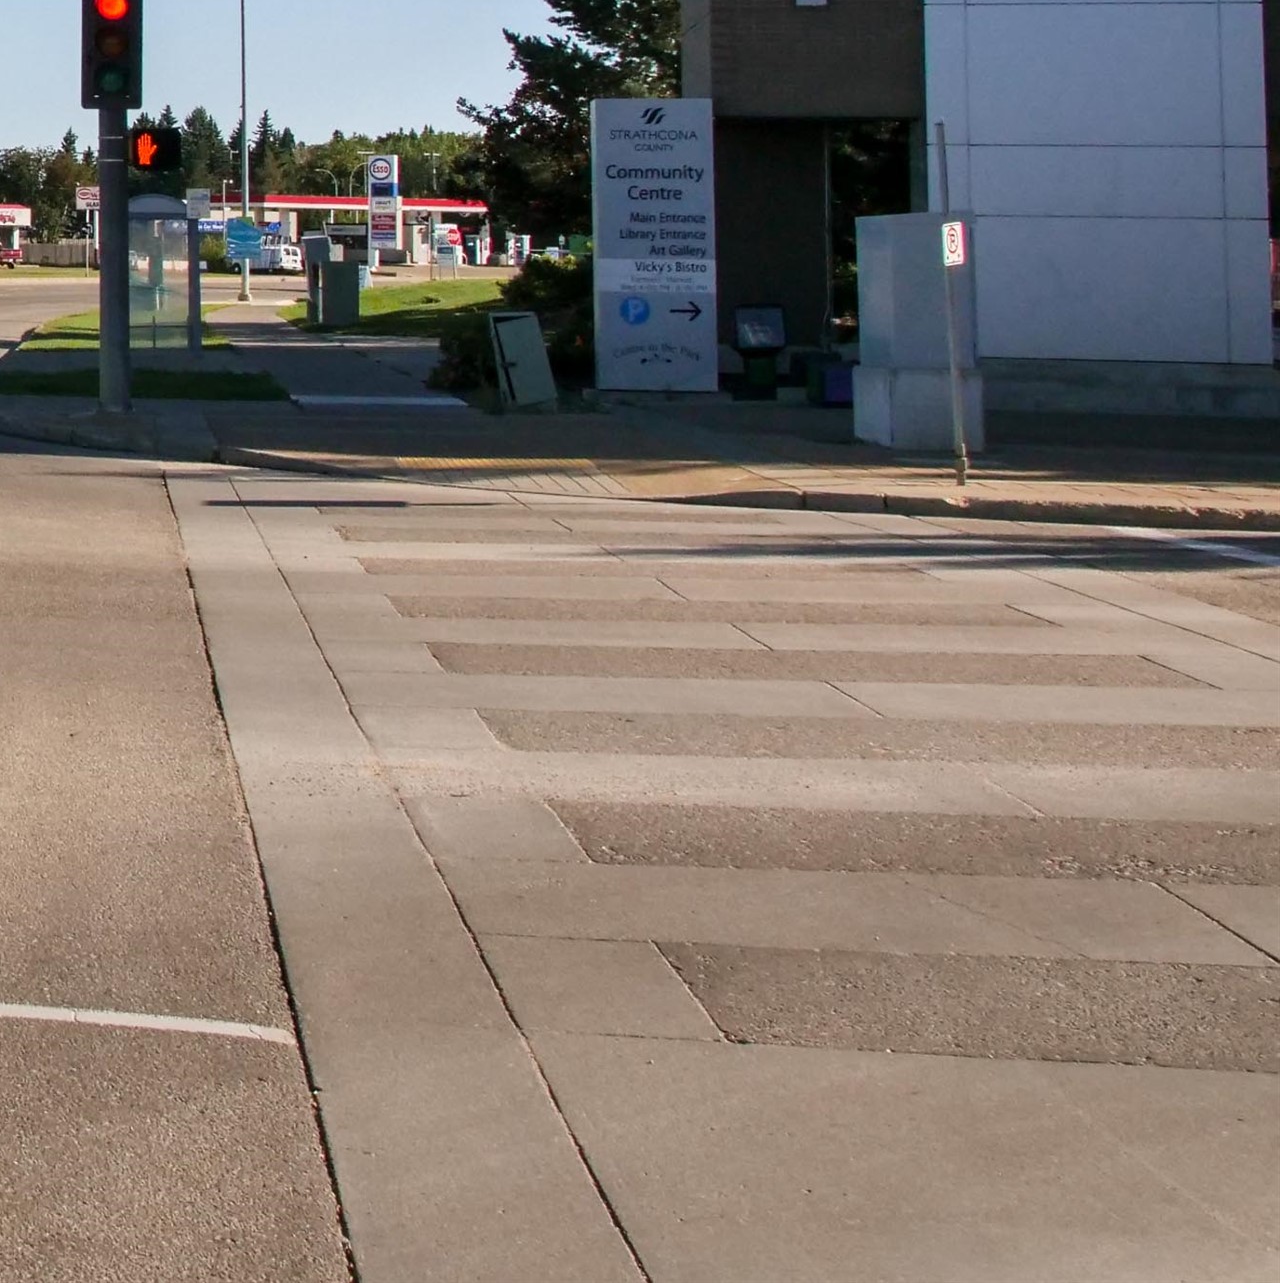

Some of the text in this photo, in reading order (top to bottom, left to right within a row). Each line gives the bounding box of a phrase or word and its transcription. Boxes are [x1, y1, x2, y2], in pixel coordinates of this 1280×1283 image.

[609, 129, 698, 140] STRATHCONA
[634, 143, 674, 152] COUNTY
[605, 164, 704, 182] Community
[627, 185, 683, 200] Centre
[629, 212, 706, 224] Main Entrance
[619, 228, 706, 242] Library Entrance
[649, 245, 707, 258] Art Gallery
[634, 261, 707, 274] Vicky's Bistro
